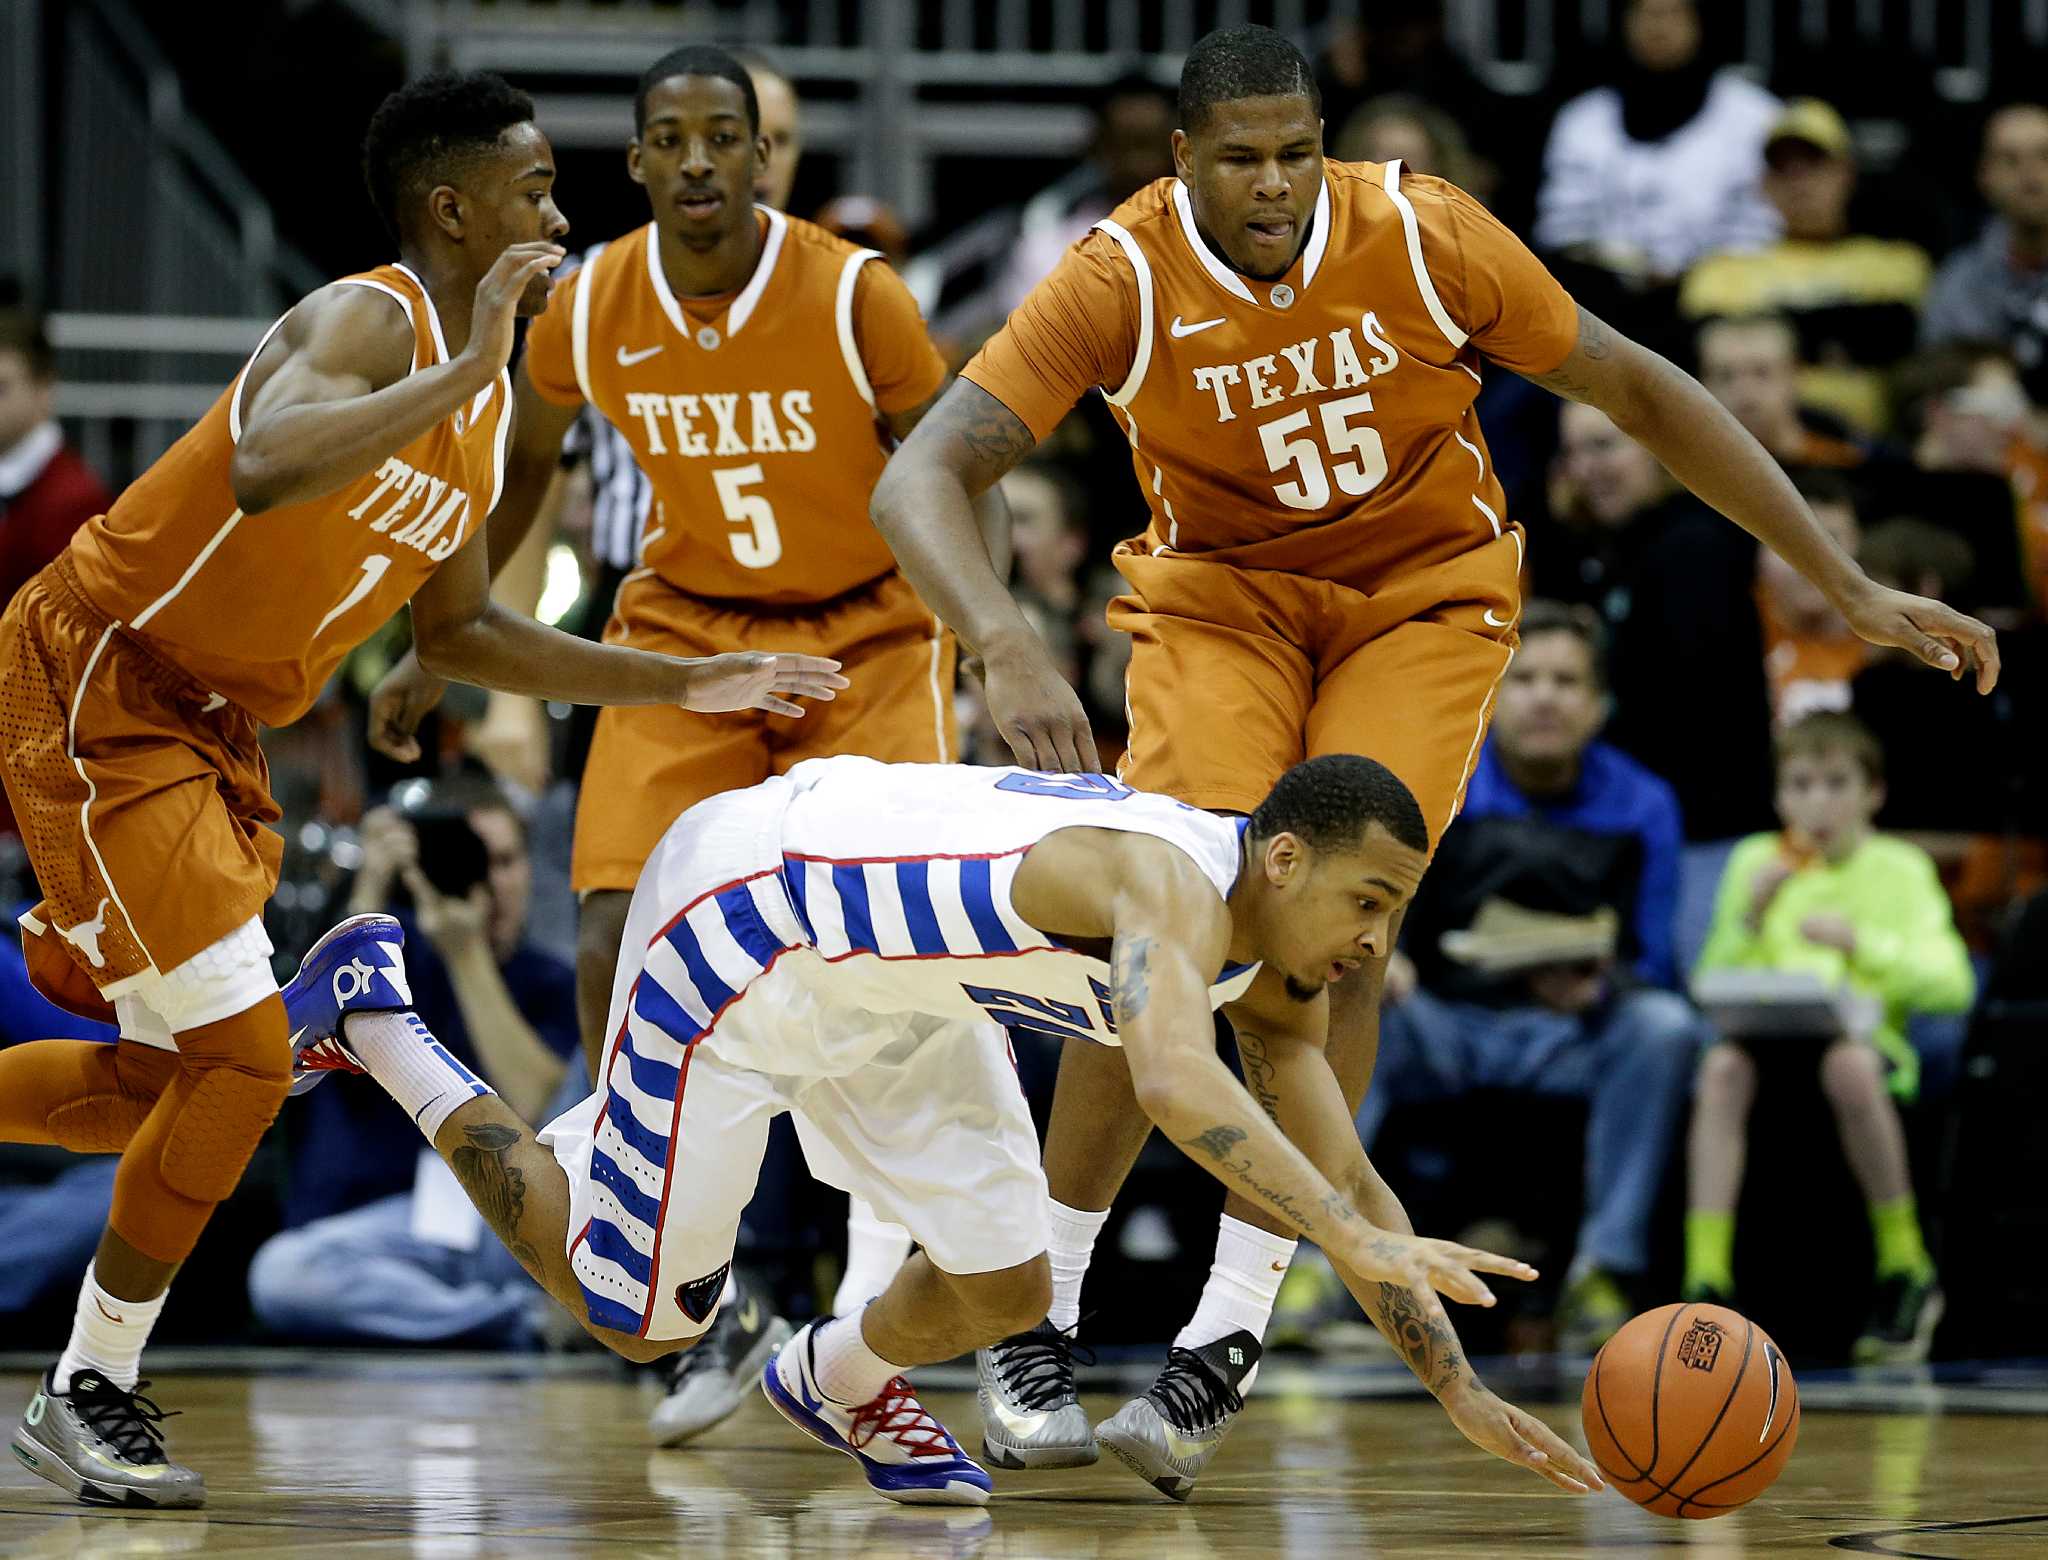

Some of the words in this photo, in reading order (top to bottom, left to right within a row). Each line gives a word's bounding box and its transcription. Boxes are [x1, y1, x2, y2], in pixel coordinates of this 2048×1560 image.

[1192, 311, 1399, 423] TEXAS
[625, 389, 816, 457] TEXAS
[1257, 391, 1389, 510] 55
[711, 462, 782, 569] 5
[311, 554, 392, 640] 1
[1221, 1159, 1315, 1232] Jonathan
